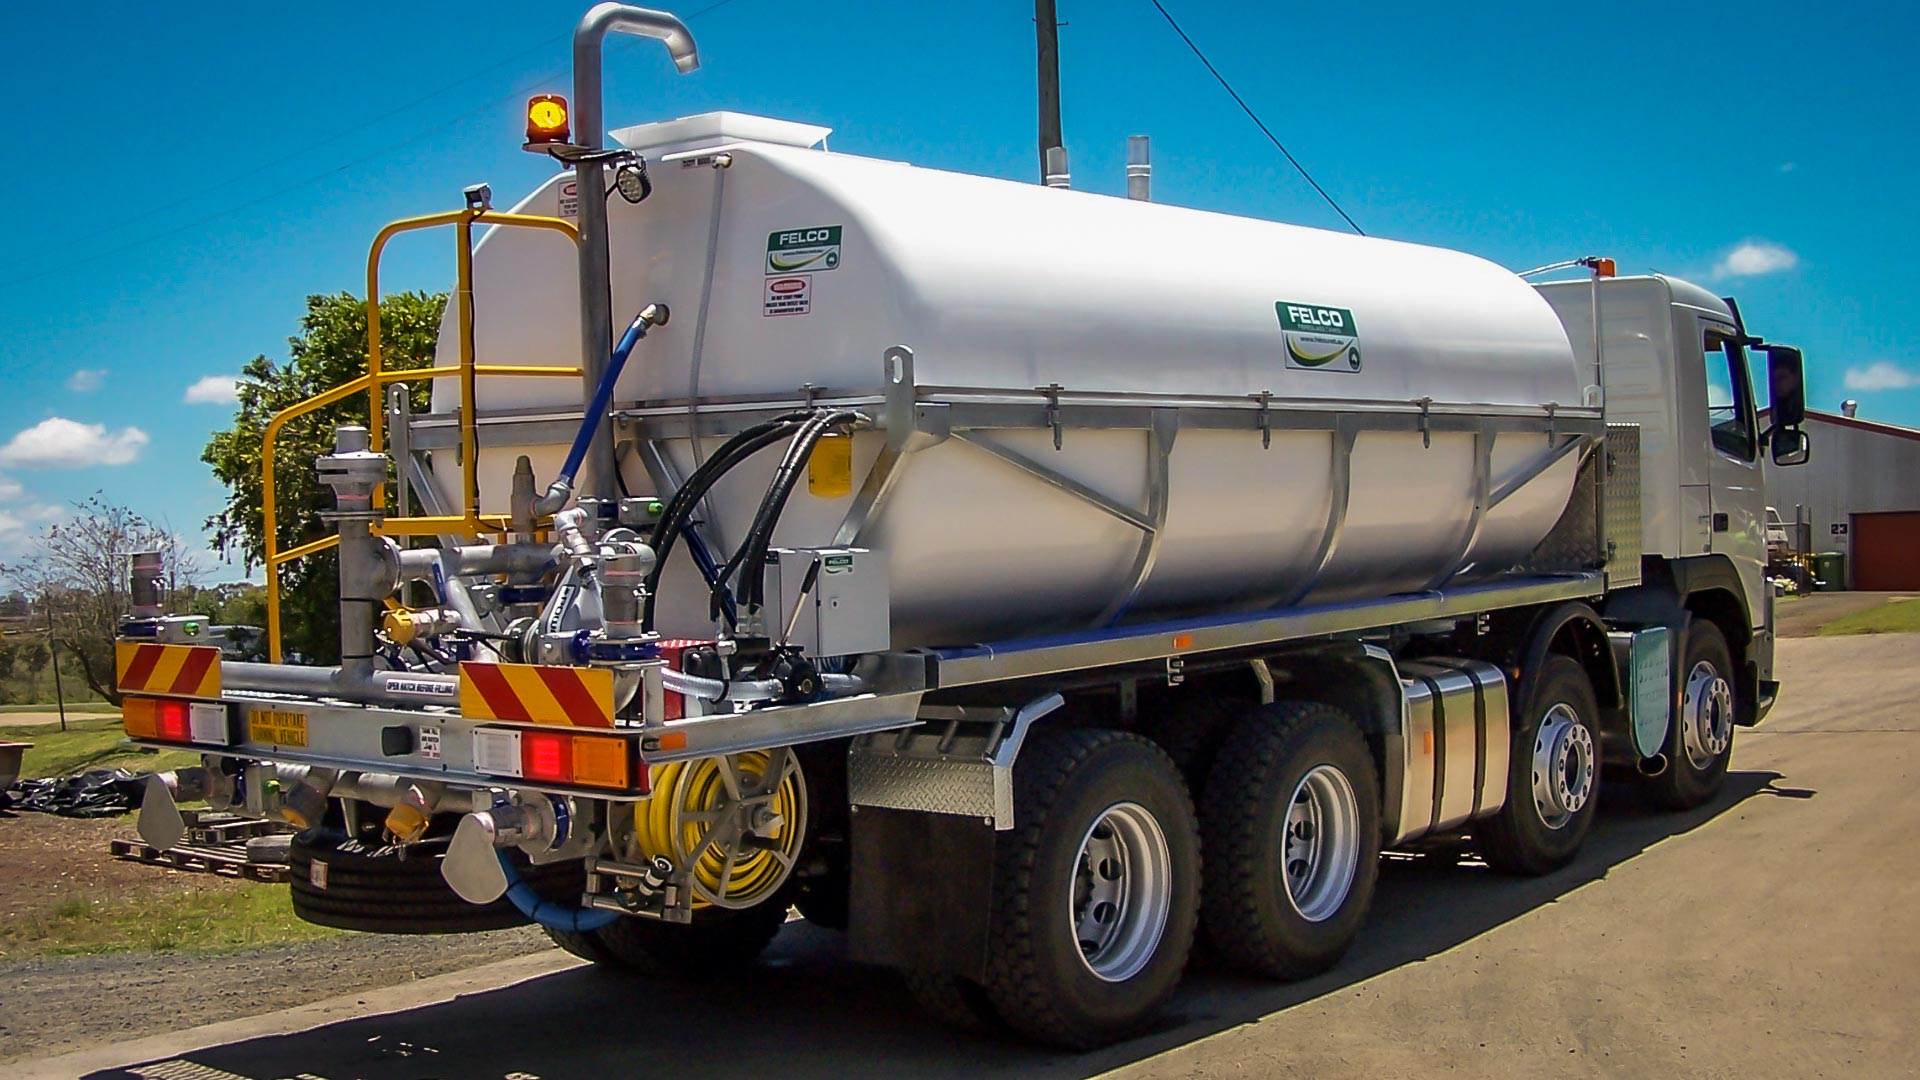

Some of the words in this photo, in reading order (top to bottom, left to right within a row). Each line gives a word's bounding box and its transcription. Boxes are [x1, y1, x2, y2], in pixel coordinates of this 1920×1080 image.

[780, 230, 829, 245] FELCO
[1287, 306, 1343, 327] FELCO
[387, 681, 400, 690] OPEN
[400, 682, 416, 691] HATCH
[416, 683, 435, 693] BEFORE
[435, 684, 454, 694] FILLING
[251, 710, 260, 725] DO
[260, 710, 273, 726] NOT
[273, 711, 305, 728] OVERTAKE
[279, 729, 305, 747] VEHICLE
